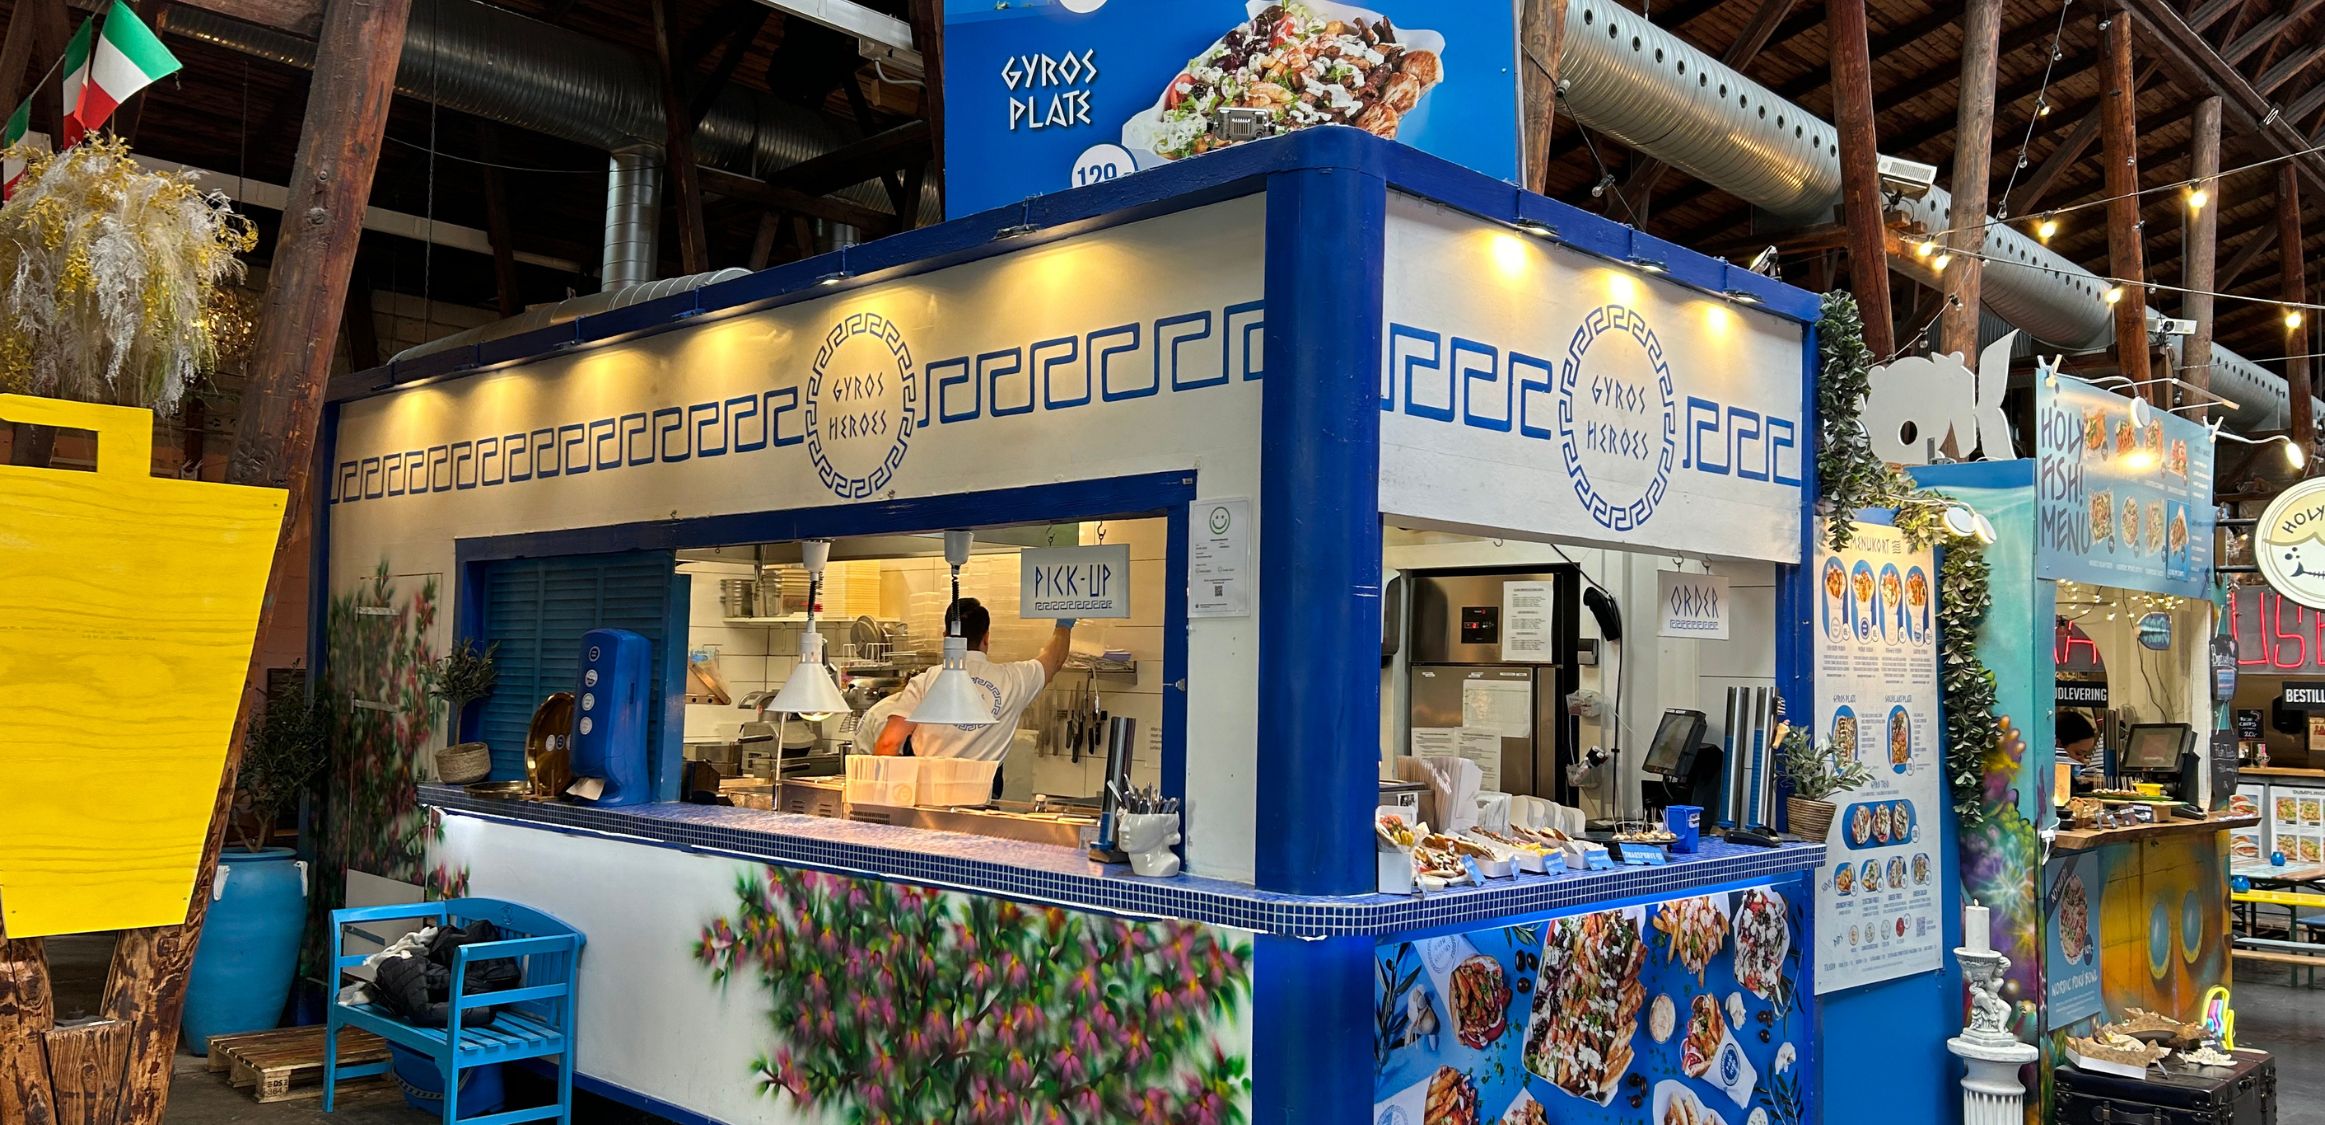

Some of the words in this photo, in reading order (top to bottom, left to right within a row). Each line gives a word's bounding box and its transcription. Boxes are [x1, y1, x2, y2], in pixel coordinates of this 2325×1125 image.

[1001, 48, 1097, 91] GYROS
[1009, 89, 1091, 130] PLATE
[833, 372, 884, 402] GYROS
[1591, 374, 1646, 414] GYROS
[829, 409, 887, 440] HEROES
[1587, 420, 1648, 460] HEROES
[2041, 406, 2085, 464] HOLY
[2041, 453, 2084, 507] FISH!
[2041, 505, 2092, 556] MENU
[2282, 504, 2325, 534] HOLY
[1035, 563, 1112, 598] PICK-UP
[1671, 584, 1719, 618] ORDER
